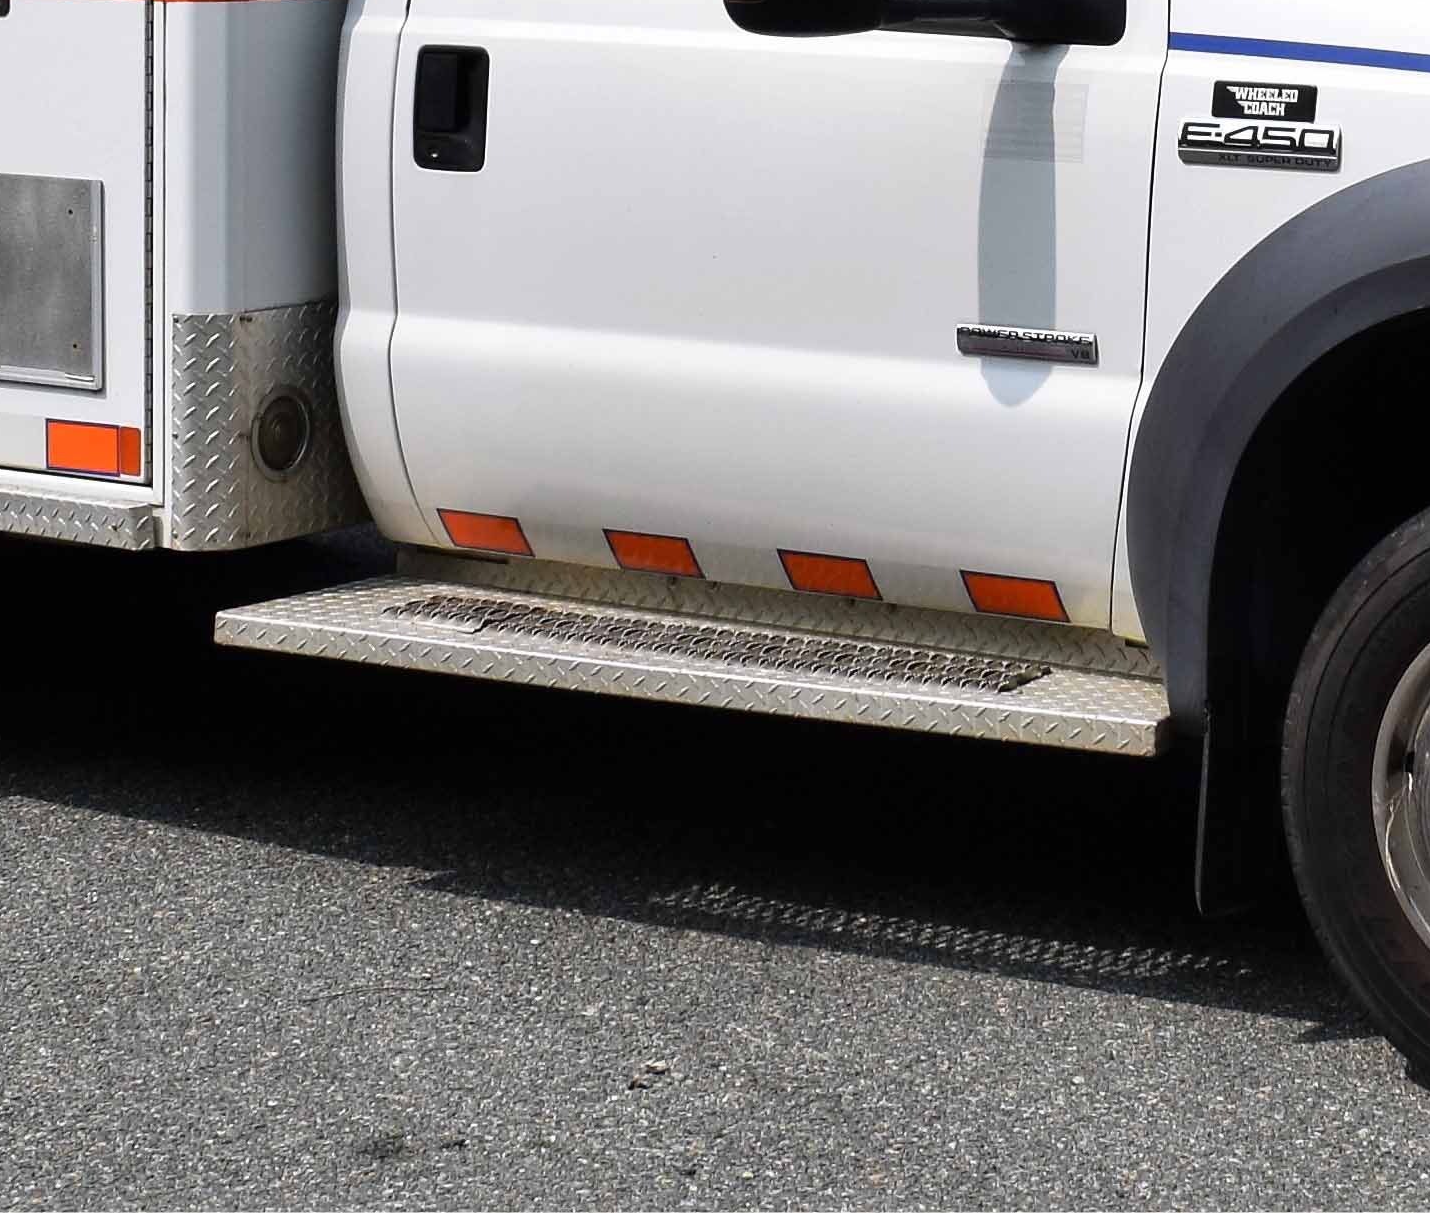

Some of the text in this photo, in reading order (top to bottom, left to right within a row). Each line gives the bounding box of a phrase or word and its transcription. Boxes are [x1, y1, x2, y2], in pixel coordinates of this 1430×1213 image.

[1226, 86, 1298, 103] WHEELED
[1237, 100, 1285, 116] COACH
[1247, 155, 1290, 165] SUPER
[1295, 157, 1332, 167] DUTY
[958, 327, 1092, 345] POWER STROKE
